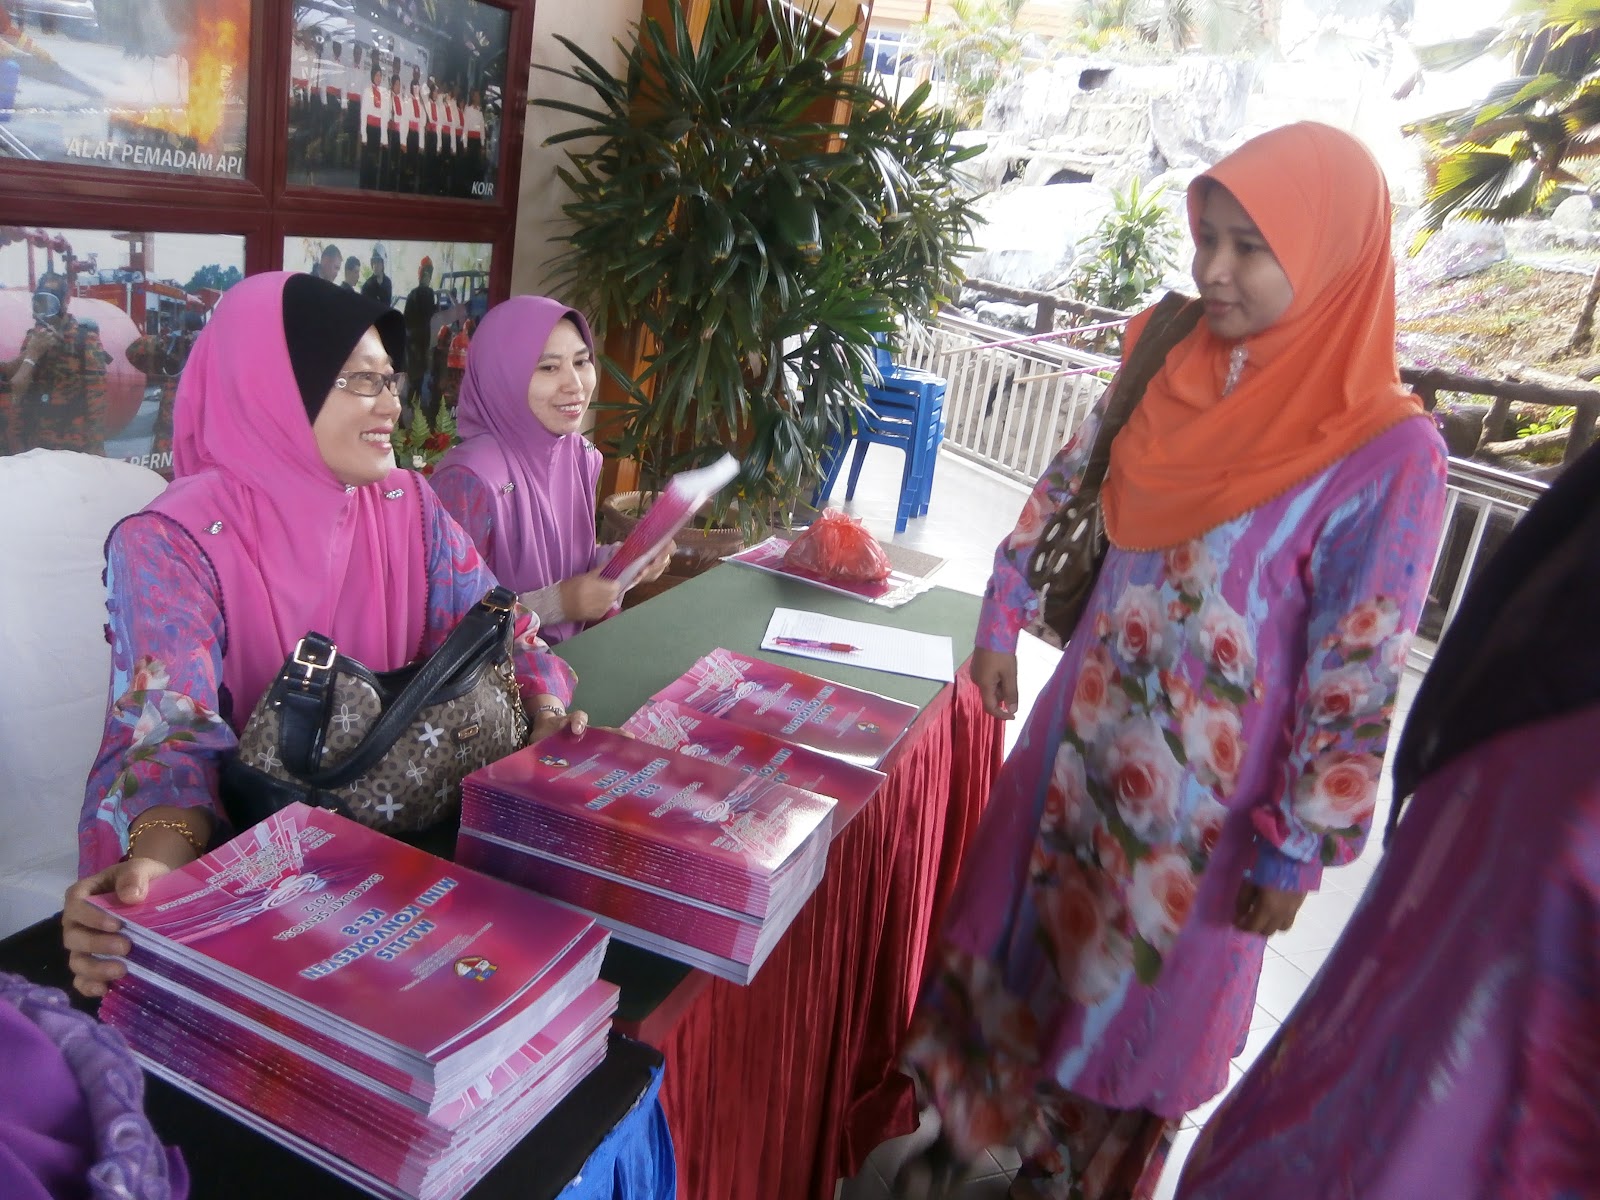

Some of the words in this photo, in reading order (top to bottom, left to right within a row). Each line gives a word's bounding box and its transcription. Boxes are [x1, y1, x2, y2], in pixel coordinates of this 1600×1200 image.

[67, 139, 118, 161] ALAT
[121, 144, 213, 171] PEMADAM
[215, 155, 243, 174] API
[471, 181, 494, 196] KOIR
[130, 451, 174, 469] PERN
[357, 873, 384, 890] SMK
[417, 877, 458, 905] MINI
[301, 893, 334, 912] 2012
[325, 889, 362, 911] BUKIT
[273, 911, 330, 941] SENTOSA
[341, 908, 385, 935] KE-8
[299, 904, 425, 980] KONVOKESYEN
[375, 919, 436, 961] MAJLIS
